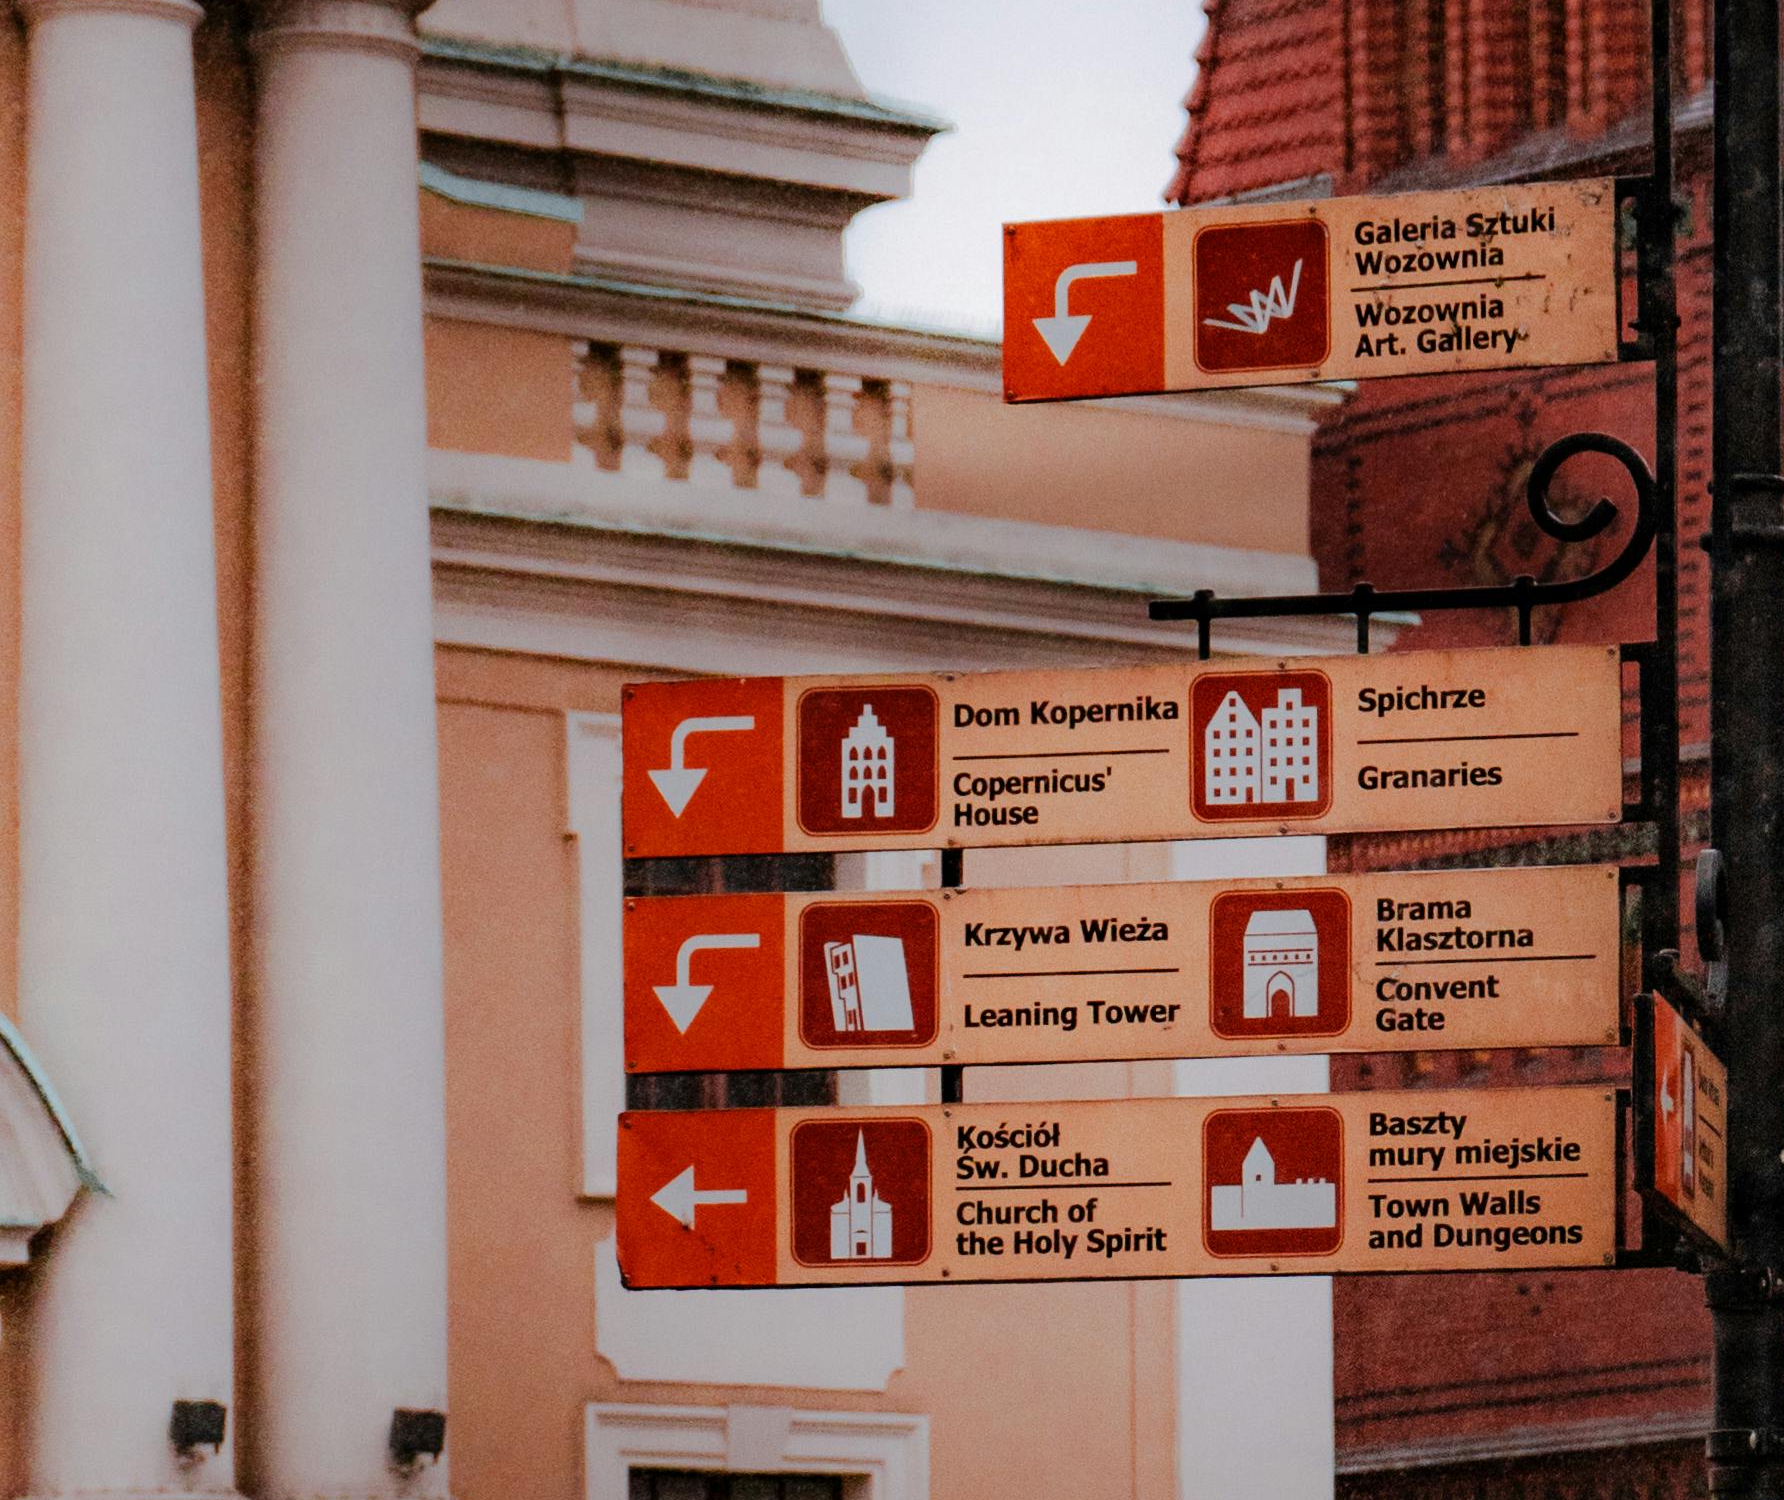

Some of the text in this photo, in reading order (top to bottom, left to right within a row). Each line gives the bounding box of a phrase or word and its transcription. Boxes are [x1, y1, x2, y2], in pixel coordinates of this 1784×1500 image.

[1355, 207, 1554, 245] Galeria Sztuki
[1355, 242, 1503, 275] Wozownia
[1355, 294, 1503, 328] Wozownia
[1355, 324, 1518, 357] Art. Gallery
[955, 696, 1178, 729] Dom Kopernika
[1359, 685, 1485, 717] Spichrze
[954, 767, 1111, 801] Copernicus'
[1358, 762, 1502, 790] Granaries
[955, 804, 1038, 826] House
[1378, 899, 1471, 921] Brama
[965, 917, 1168, 951] Krzywa Wieża
[1377, 927, 1533, 951] Klasztorna
[1376, 976, 1499, 1001] Convent
[965, 1001, 1180, 1031] Leaning Tower
[1376, 1008, 1444, 1032] Gate
[958, 1122, 1060, 1150] Kościół
[1370, 1112, 1466, 1139] Baszty
[957, 1148, 1108, 1179] Św. Ducha
[1370, 1137, 1580, 1171] mury miejskie
[957, 1198, 1097, 1225] Church of
[1368, 1190, 1540, 1218] Town Walls
[957, 1227, 1166, 1259] the Holy Spirit
[1369, 1224, 1582, 1252] and Dungeons
